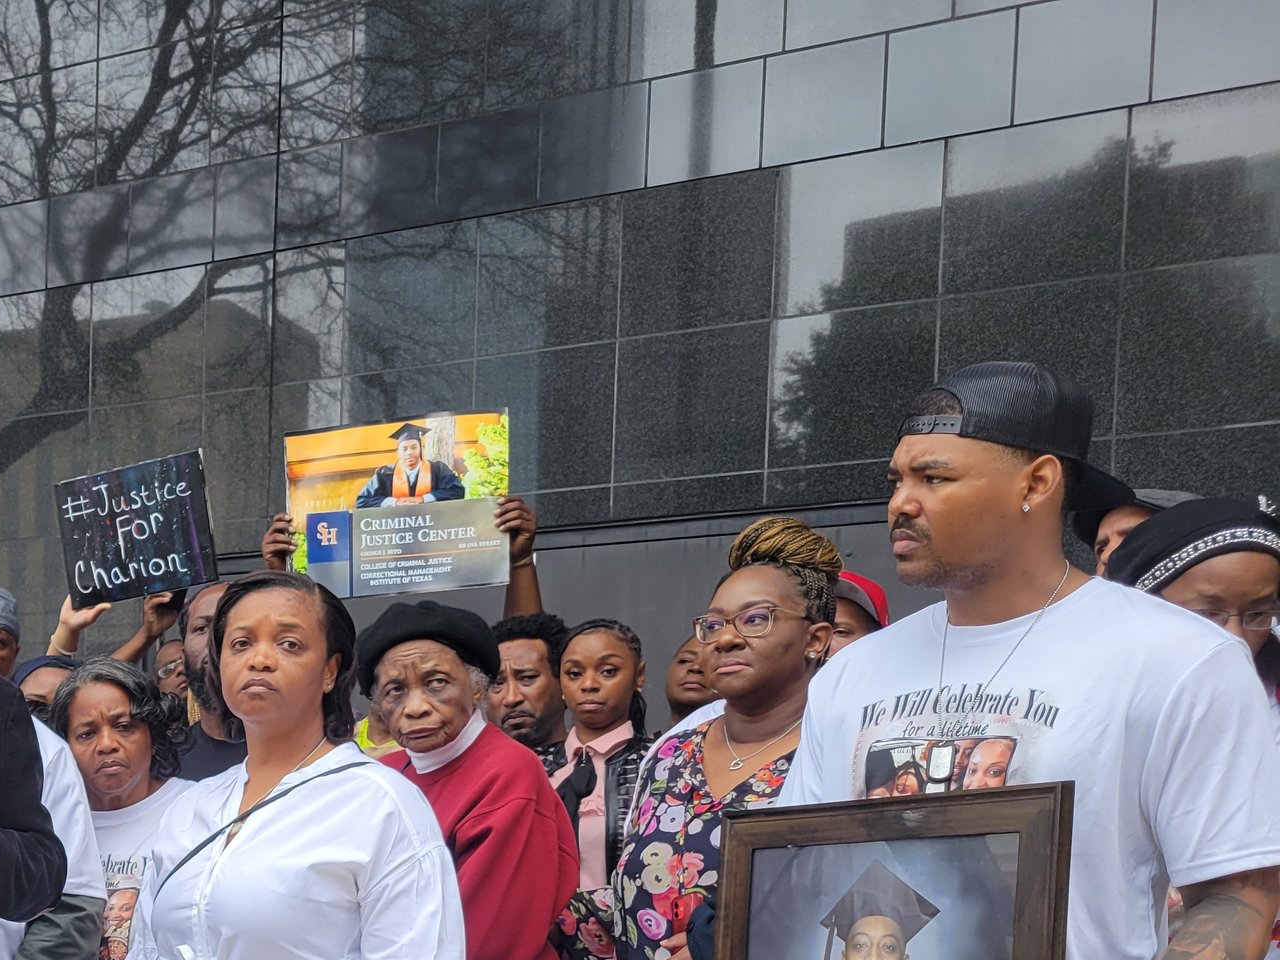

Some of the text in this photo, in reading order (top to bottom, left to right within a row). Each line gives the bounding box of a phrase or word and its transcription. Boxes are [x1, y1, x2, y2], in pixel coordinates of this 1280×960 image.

[62, 481, 192, 521] #Justice
[360, 515, 434, 532] CRIMINAL
[115, 512, 163, 559] For
[360, 526, 476, 549] JUSTICE CENTER
[74, 553, 188, 593] Charion
[360, 557, 453, 571] COLLEGE OF CRIMINAL JUSTICE
[360, 566, 453, 580] CORRECTIONAL MANAGEMENT
[370, 575, 433, 586] INSTITUTE OF TEXAS
[861, 683, 1060, 732] We Will Celebrate You
[903, 720, 990, 738] for a lifetime
